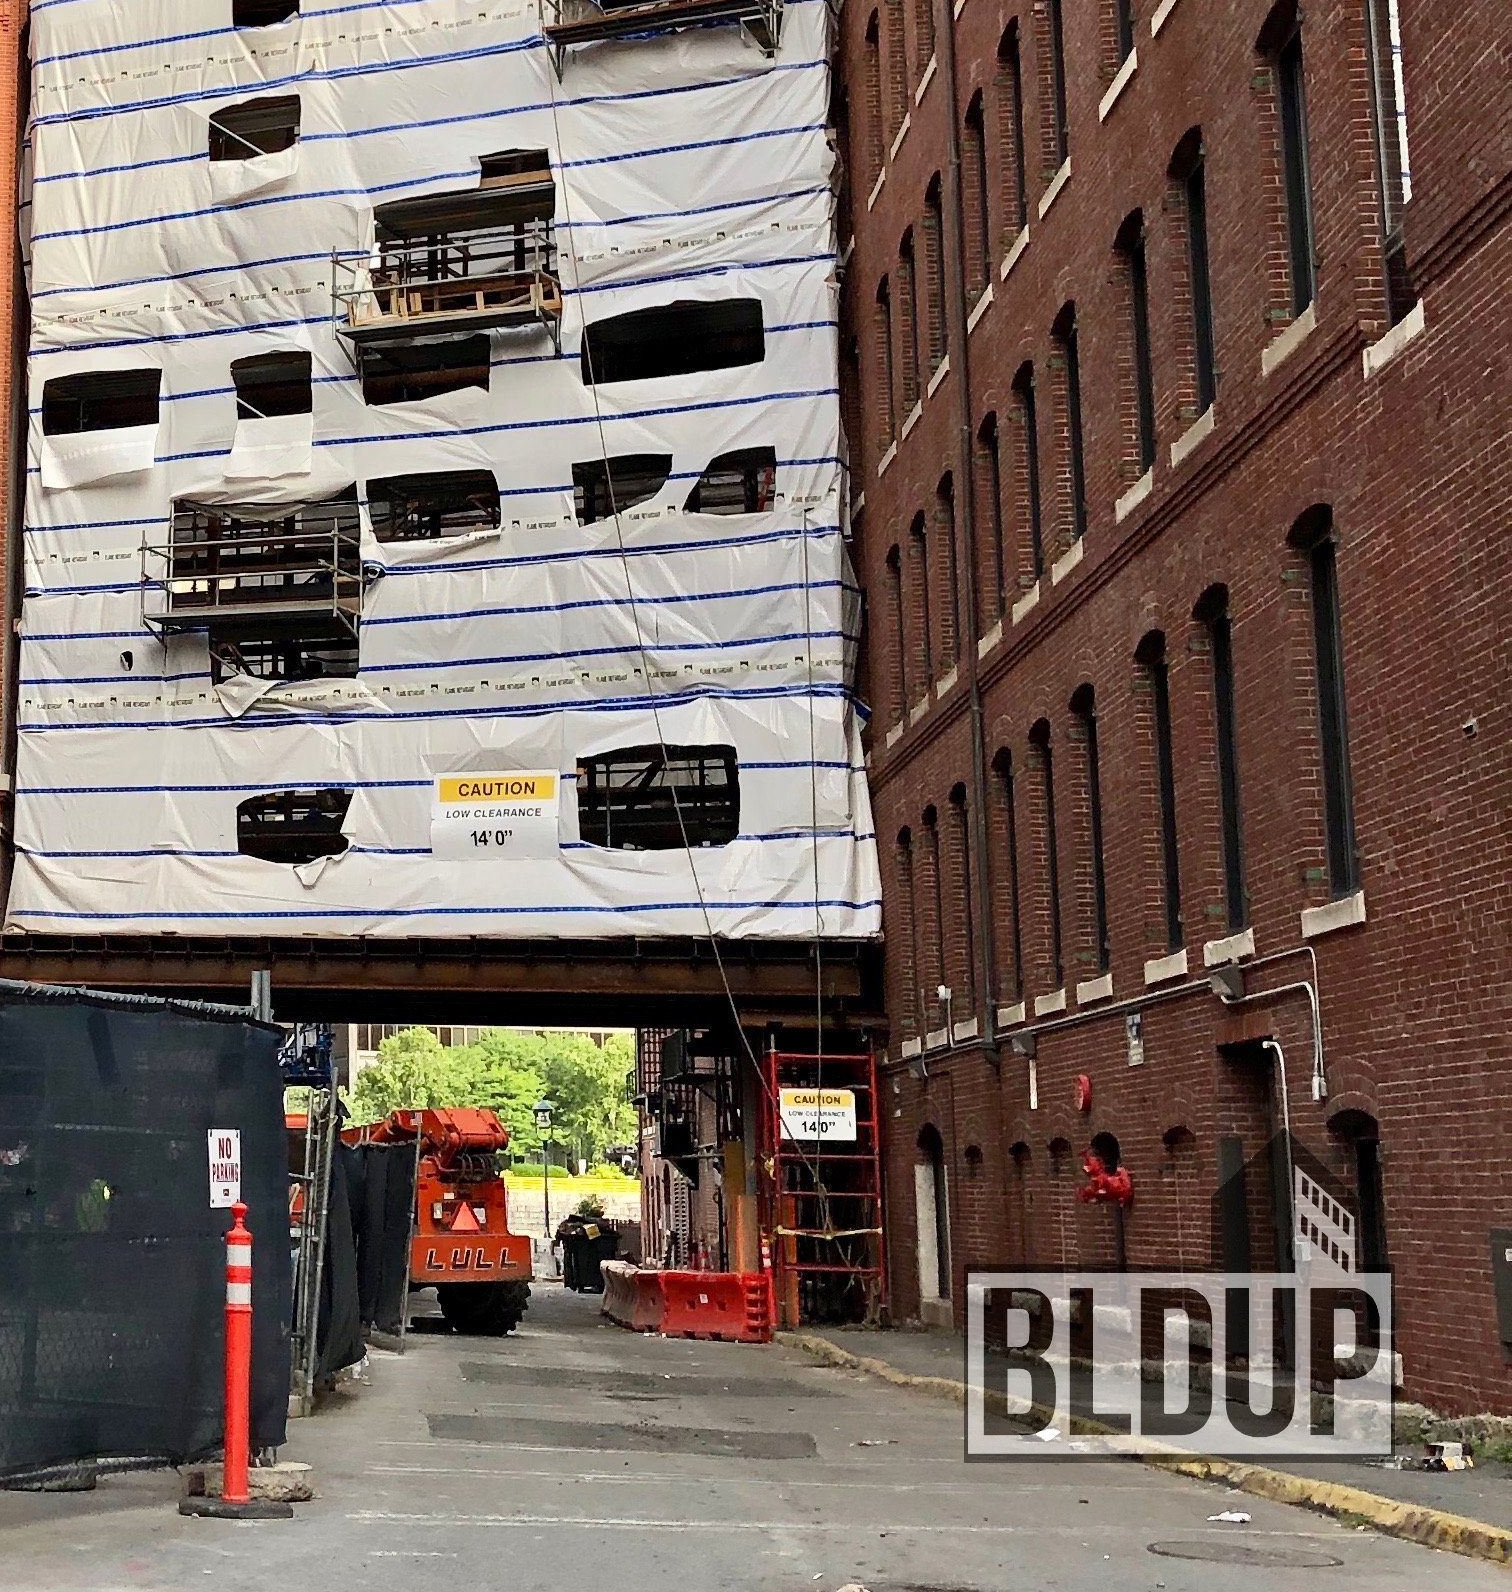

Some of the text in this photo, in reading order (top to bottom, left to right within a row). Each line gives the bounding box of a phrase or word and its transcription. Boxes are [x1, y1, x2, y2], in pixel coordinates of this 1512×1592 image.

[458, 781, 536, 797] CAUTION
[445, 807, 542, 819] LOW CLEARANCE
[794, 1095, 841, 1105] CAUTION
[218, 1136, 232, 1159] NO
[212, 1162, 239, 1182] PARKING
[425, 1248, 518, 1271] LULL
